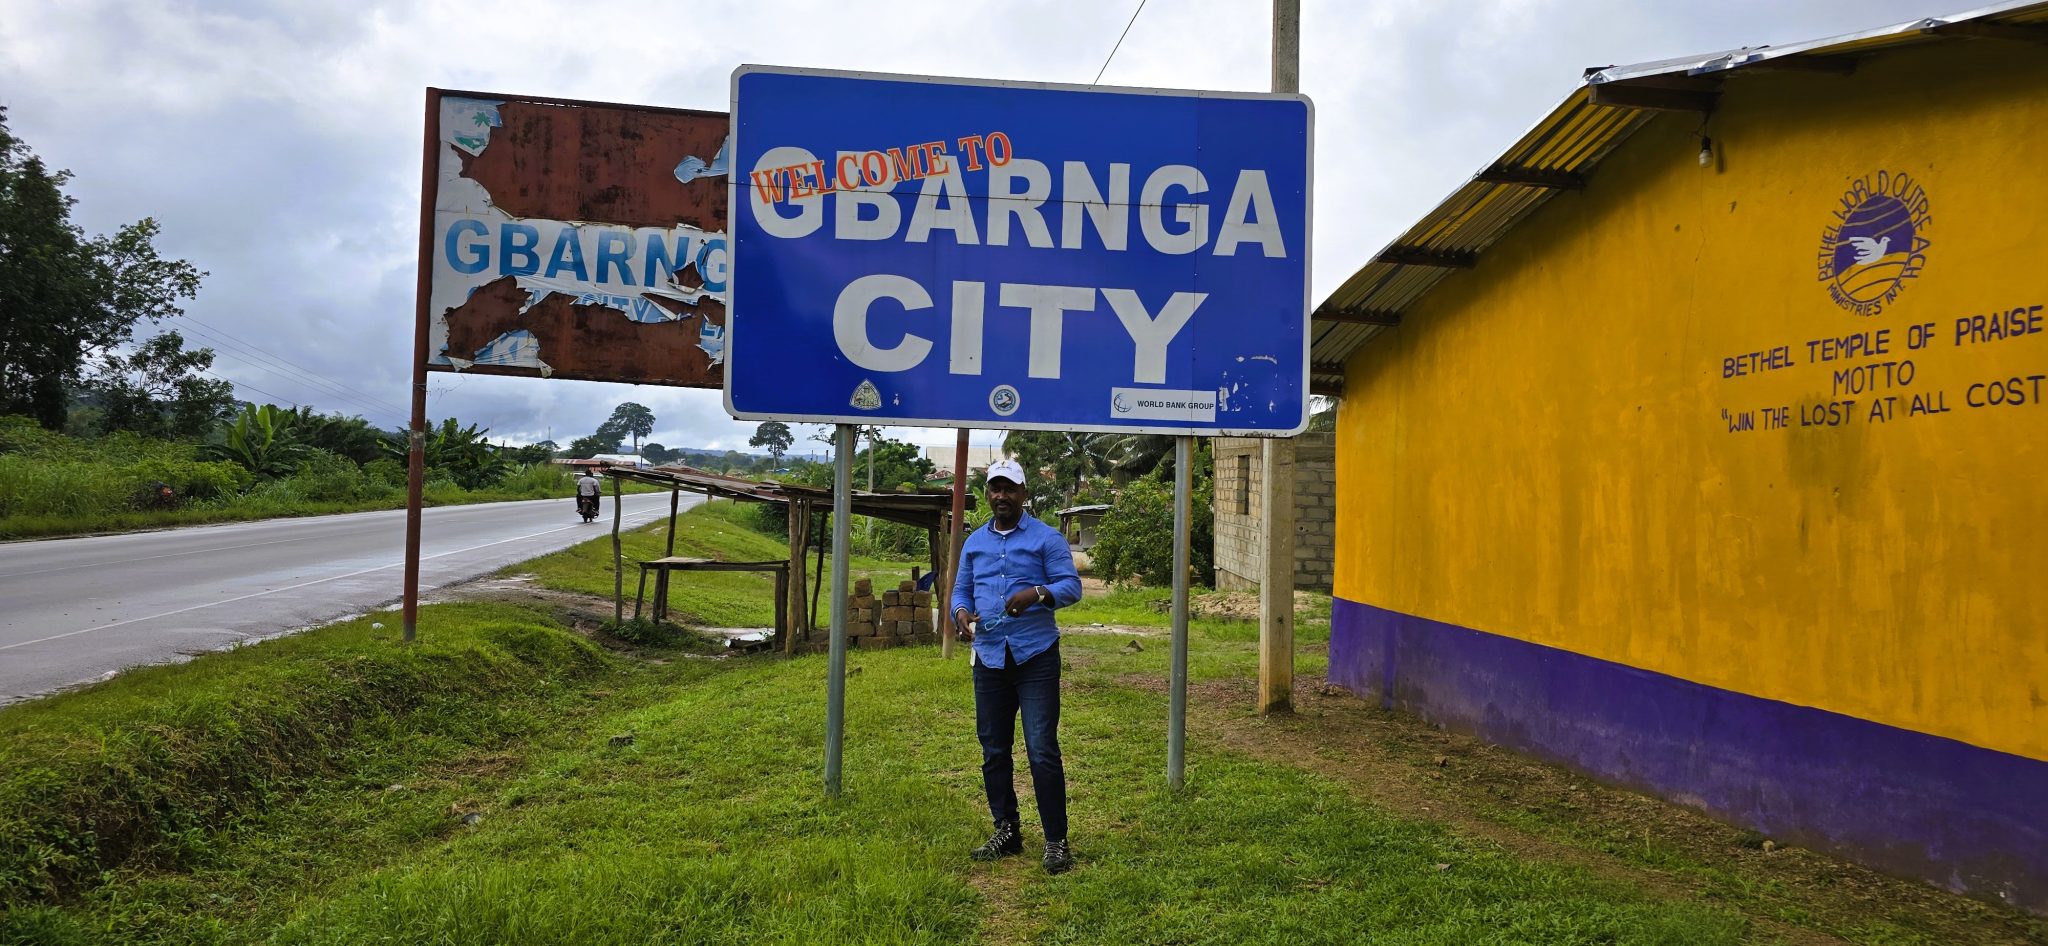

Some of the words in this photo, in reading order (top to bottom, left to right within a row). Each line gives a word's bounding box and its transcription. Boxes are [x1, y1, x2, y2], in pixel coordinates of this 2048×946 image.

[749, 140, 950, 205] WELCOME
[958, 131, 1013, 171] TO
[750, 147, 1287, 259] GBARNGA
[1818, 224, 1842, 282] BETHEL
[1832, 169, 1890, 220] WORLD
[832, 274, 1209, 385] CITY
[1827, 283, 1882, 317] MINISTRIES
[1722, 346, 1794, 378] BETHEL
[1806, 329, 1890, 363] TEMPLE
[1908, 322, 1935, 350] OF
[1954, 305, 2044, 346] PRAISE
[1833, 360, 1915, 396] MOTTO
[1137, 400, 1164, 408] WORLD
[1166, 401, 1186, 409] BANK
[1188, 402, 1214, 410] GROUP
[1761, 406, 1789, 430] THE
[1801, 400, 1855, 427] LOST
[1868, 397, 1897, 423] AT
[1910, 391, 1950, 417] ALL
[1966, 375, 2046, 408] COST
